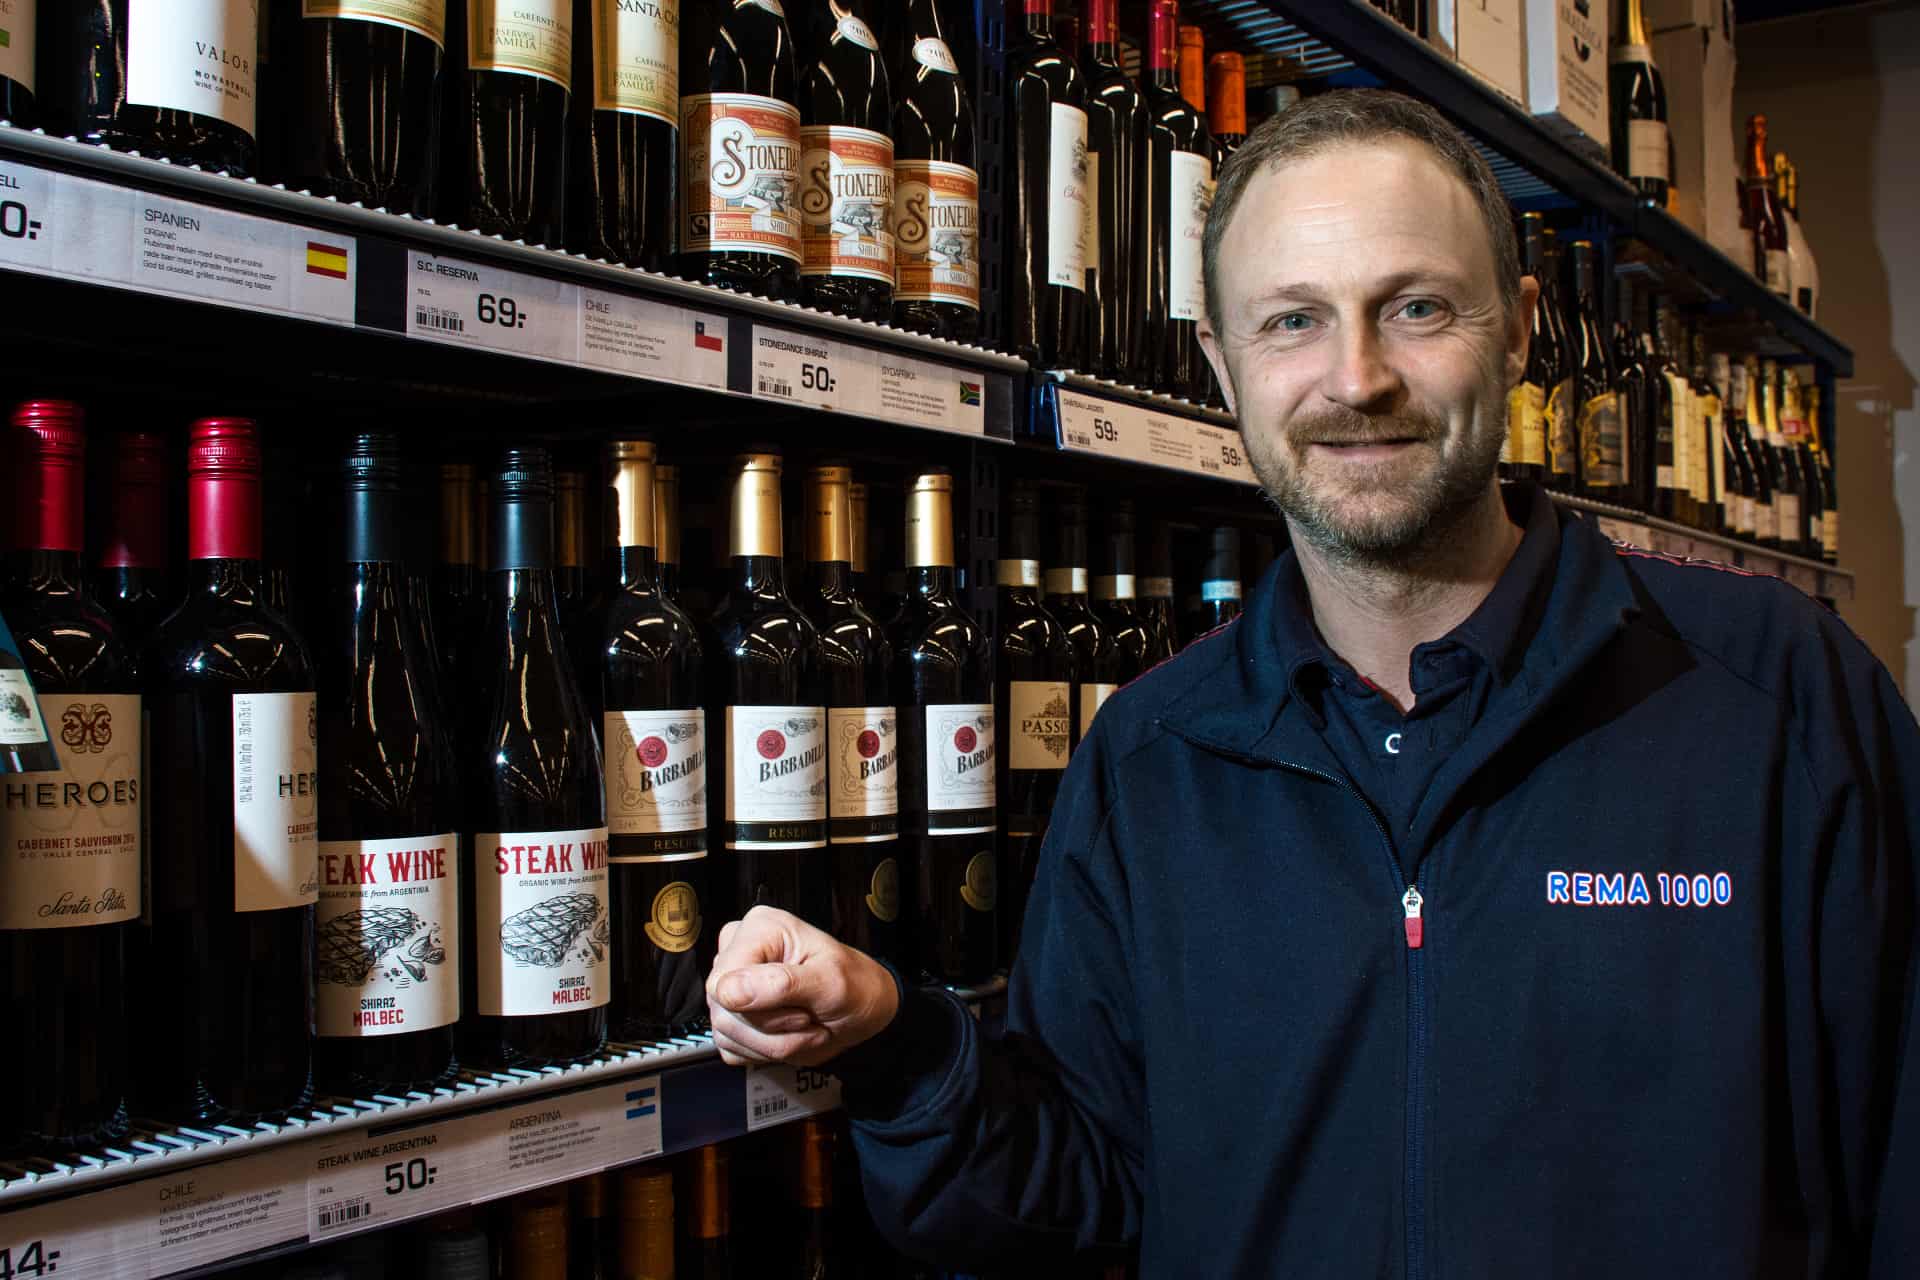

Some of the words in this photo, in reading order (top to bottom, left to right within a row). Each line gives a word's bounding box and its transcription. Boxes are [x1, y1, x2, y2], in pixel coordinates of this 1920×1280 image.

[144, 208, 200, 231] SPANIEN
[436, 264, 480, 282] RESERVA
[585, 299, 611, 313] CHILE
[6, 779, 138, 808] HEROES
[18, 838, 72, 850] CABERNET
[73, 835, 122, 848] SAUVIGNON
[387, 848, 447, 883] WINE
[495, 843, 573, 875] STEAK
[519, 879, 549, 887] ORGANIC
[1547, 871, 1651, 906] REMA
[1657, 872, 1731, 908] 1000
[370, 889, 388, 900] from
[38, 891, 91, 918] Santa
[559, 976, 585, 988] SHIRAZ
[361, 997, 395, 1010] SHIRAZ
[552, 987, 591, 1004] MALBEC
[353, 1009, 404, 1027] MALBEC
[510, 1109, 562, 1130] ARGENTINA
[318, 1154, 351, 1169] STEAK
[353, 1146, 380, 1161] WINE
[382, 1135, 438, 1156] ARGENTINA
[160, 1182, 195, 1201] CHILE
